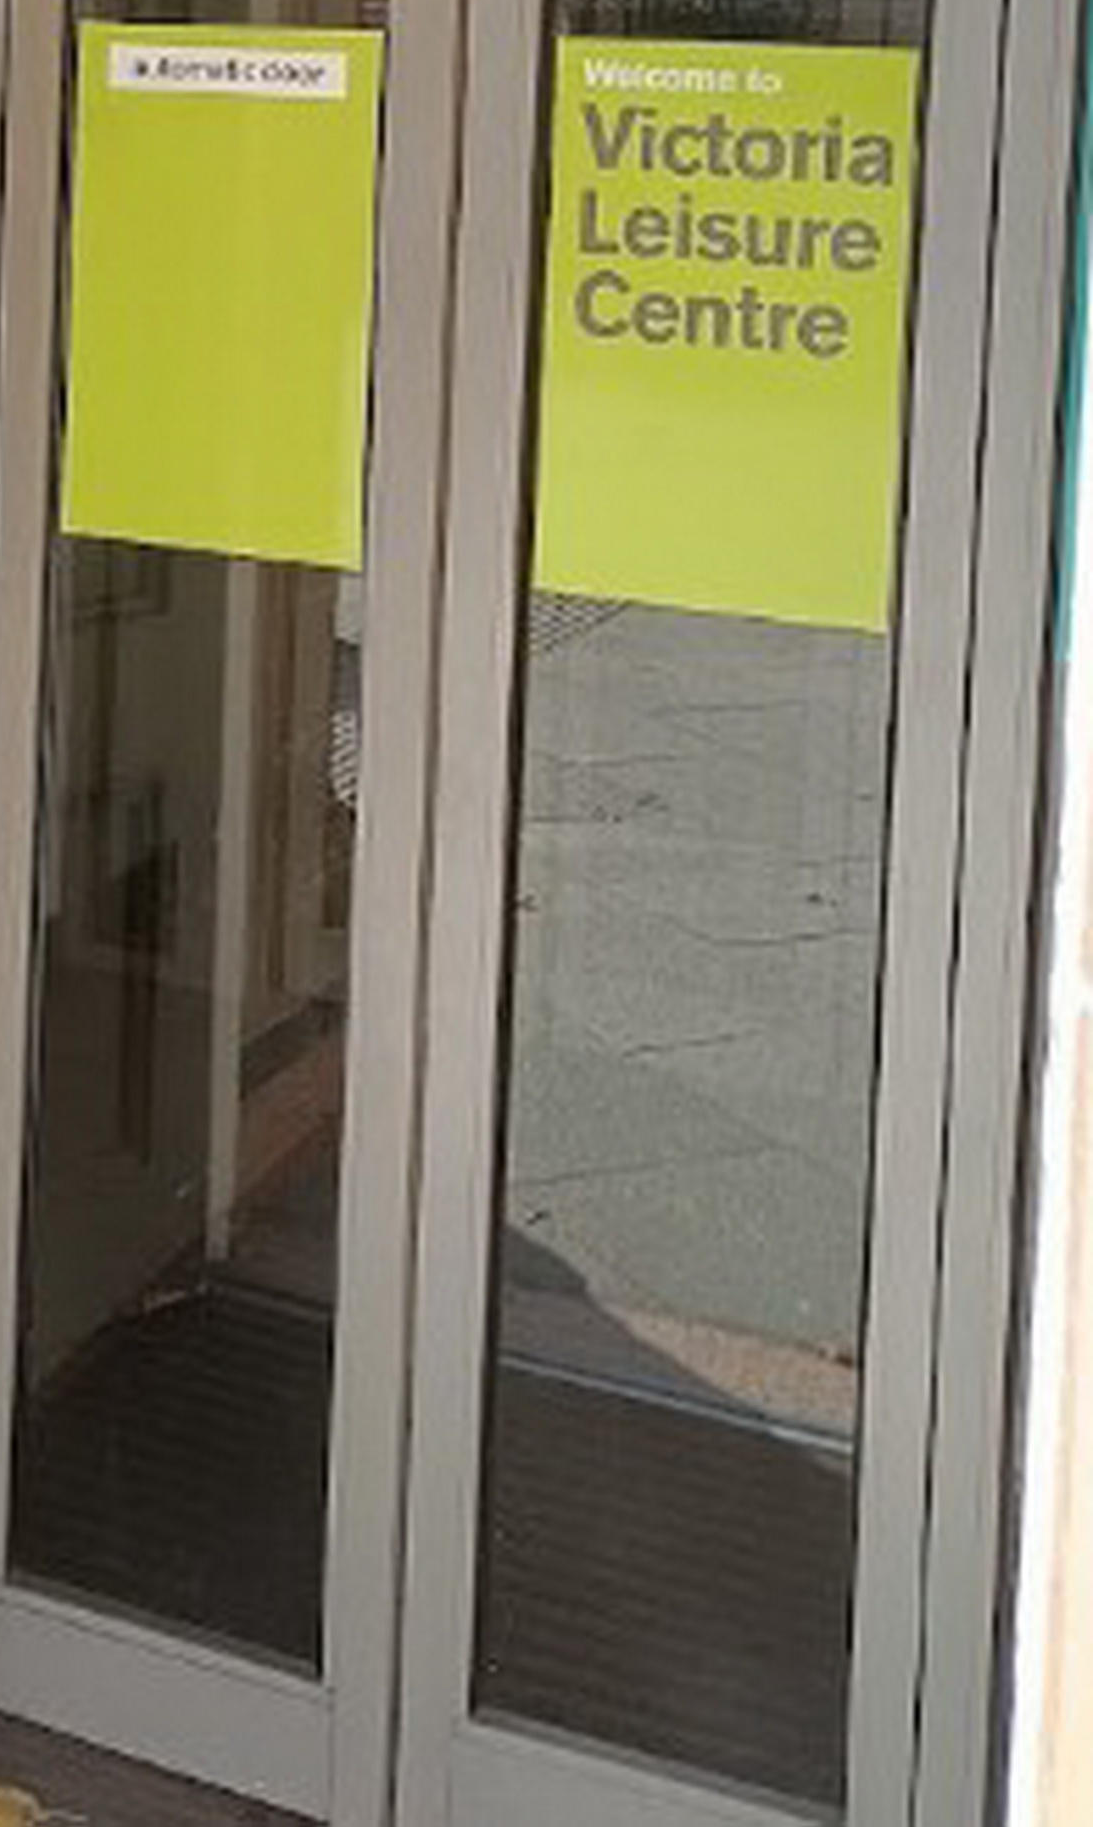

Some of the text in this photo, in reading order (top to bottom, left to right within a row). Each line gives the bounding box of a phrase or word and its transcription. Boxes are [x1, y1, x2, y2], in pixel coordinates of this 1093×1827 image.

[584, 58, 783, 93] Welcome to
[582, 102, 894, 187] Victoria
[578, 189, 882, 272] Leisure
[573, 270, 850, 358] Centre
